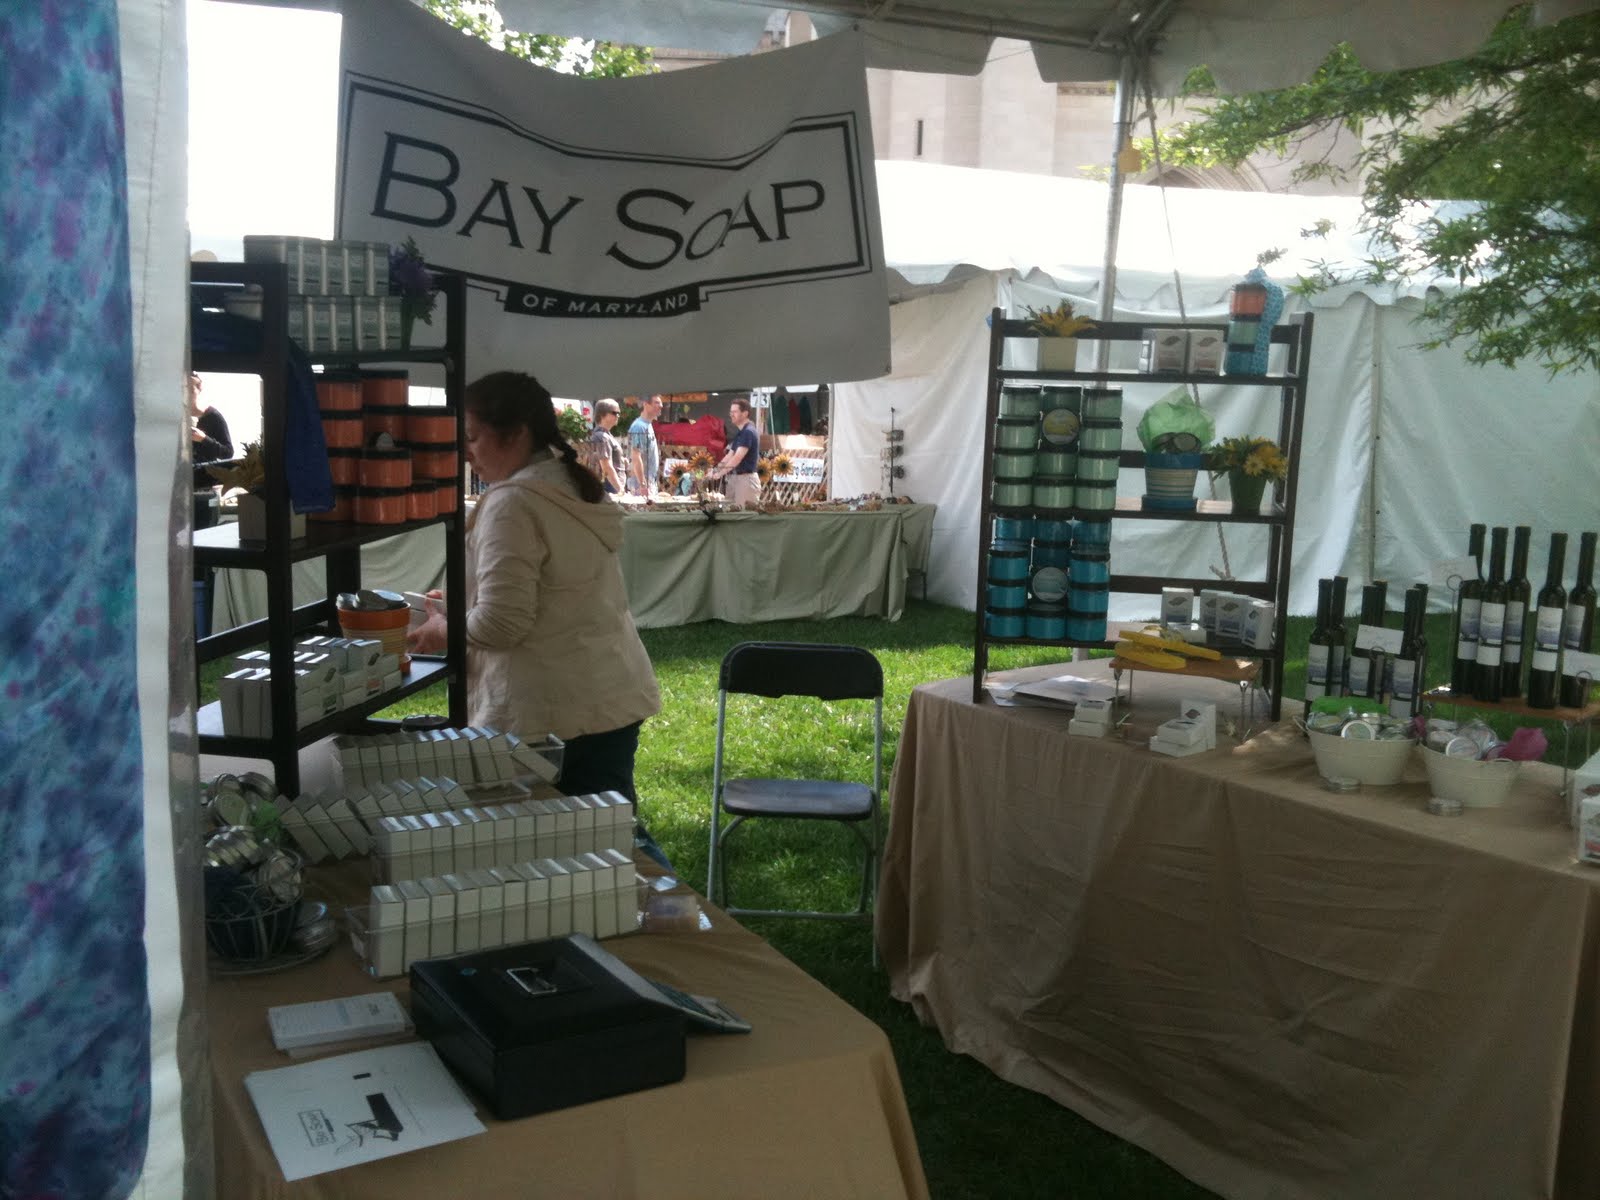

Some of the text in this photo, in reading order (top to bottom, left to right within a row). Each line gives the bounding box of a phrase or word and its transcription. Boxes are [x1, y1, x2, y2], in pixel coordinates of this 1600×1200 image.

[370, 131, 825, 270] BAY SOAP
[522, 293, 689, 313] OF MARYLAND
